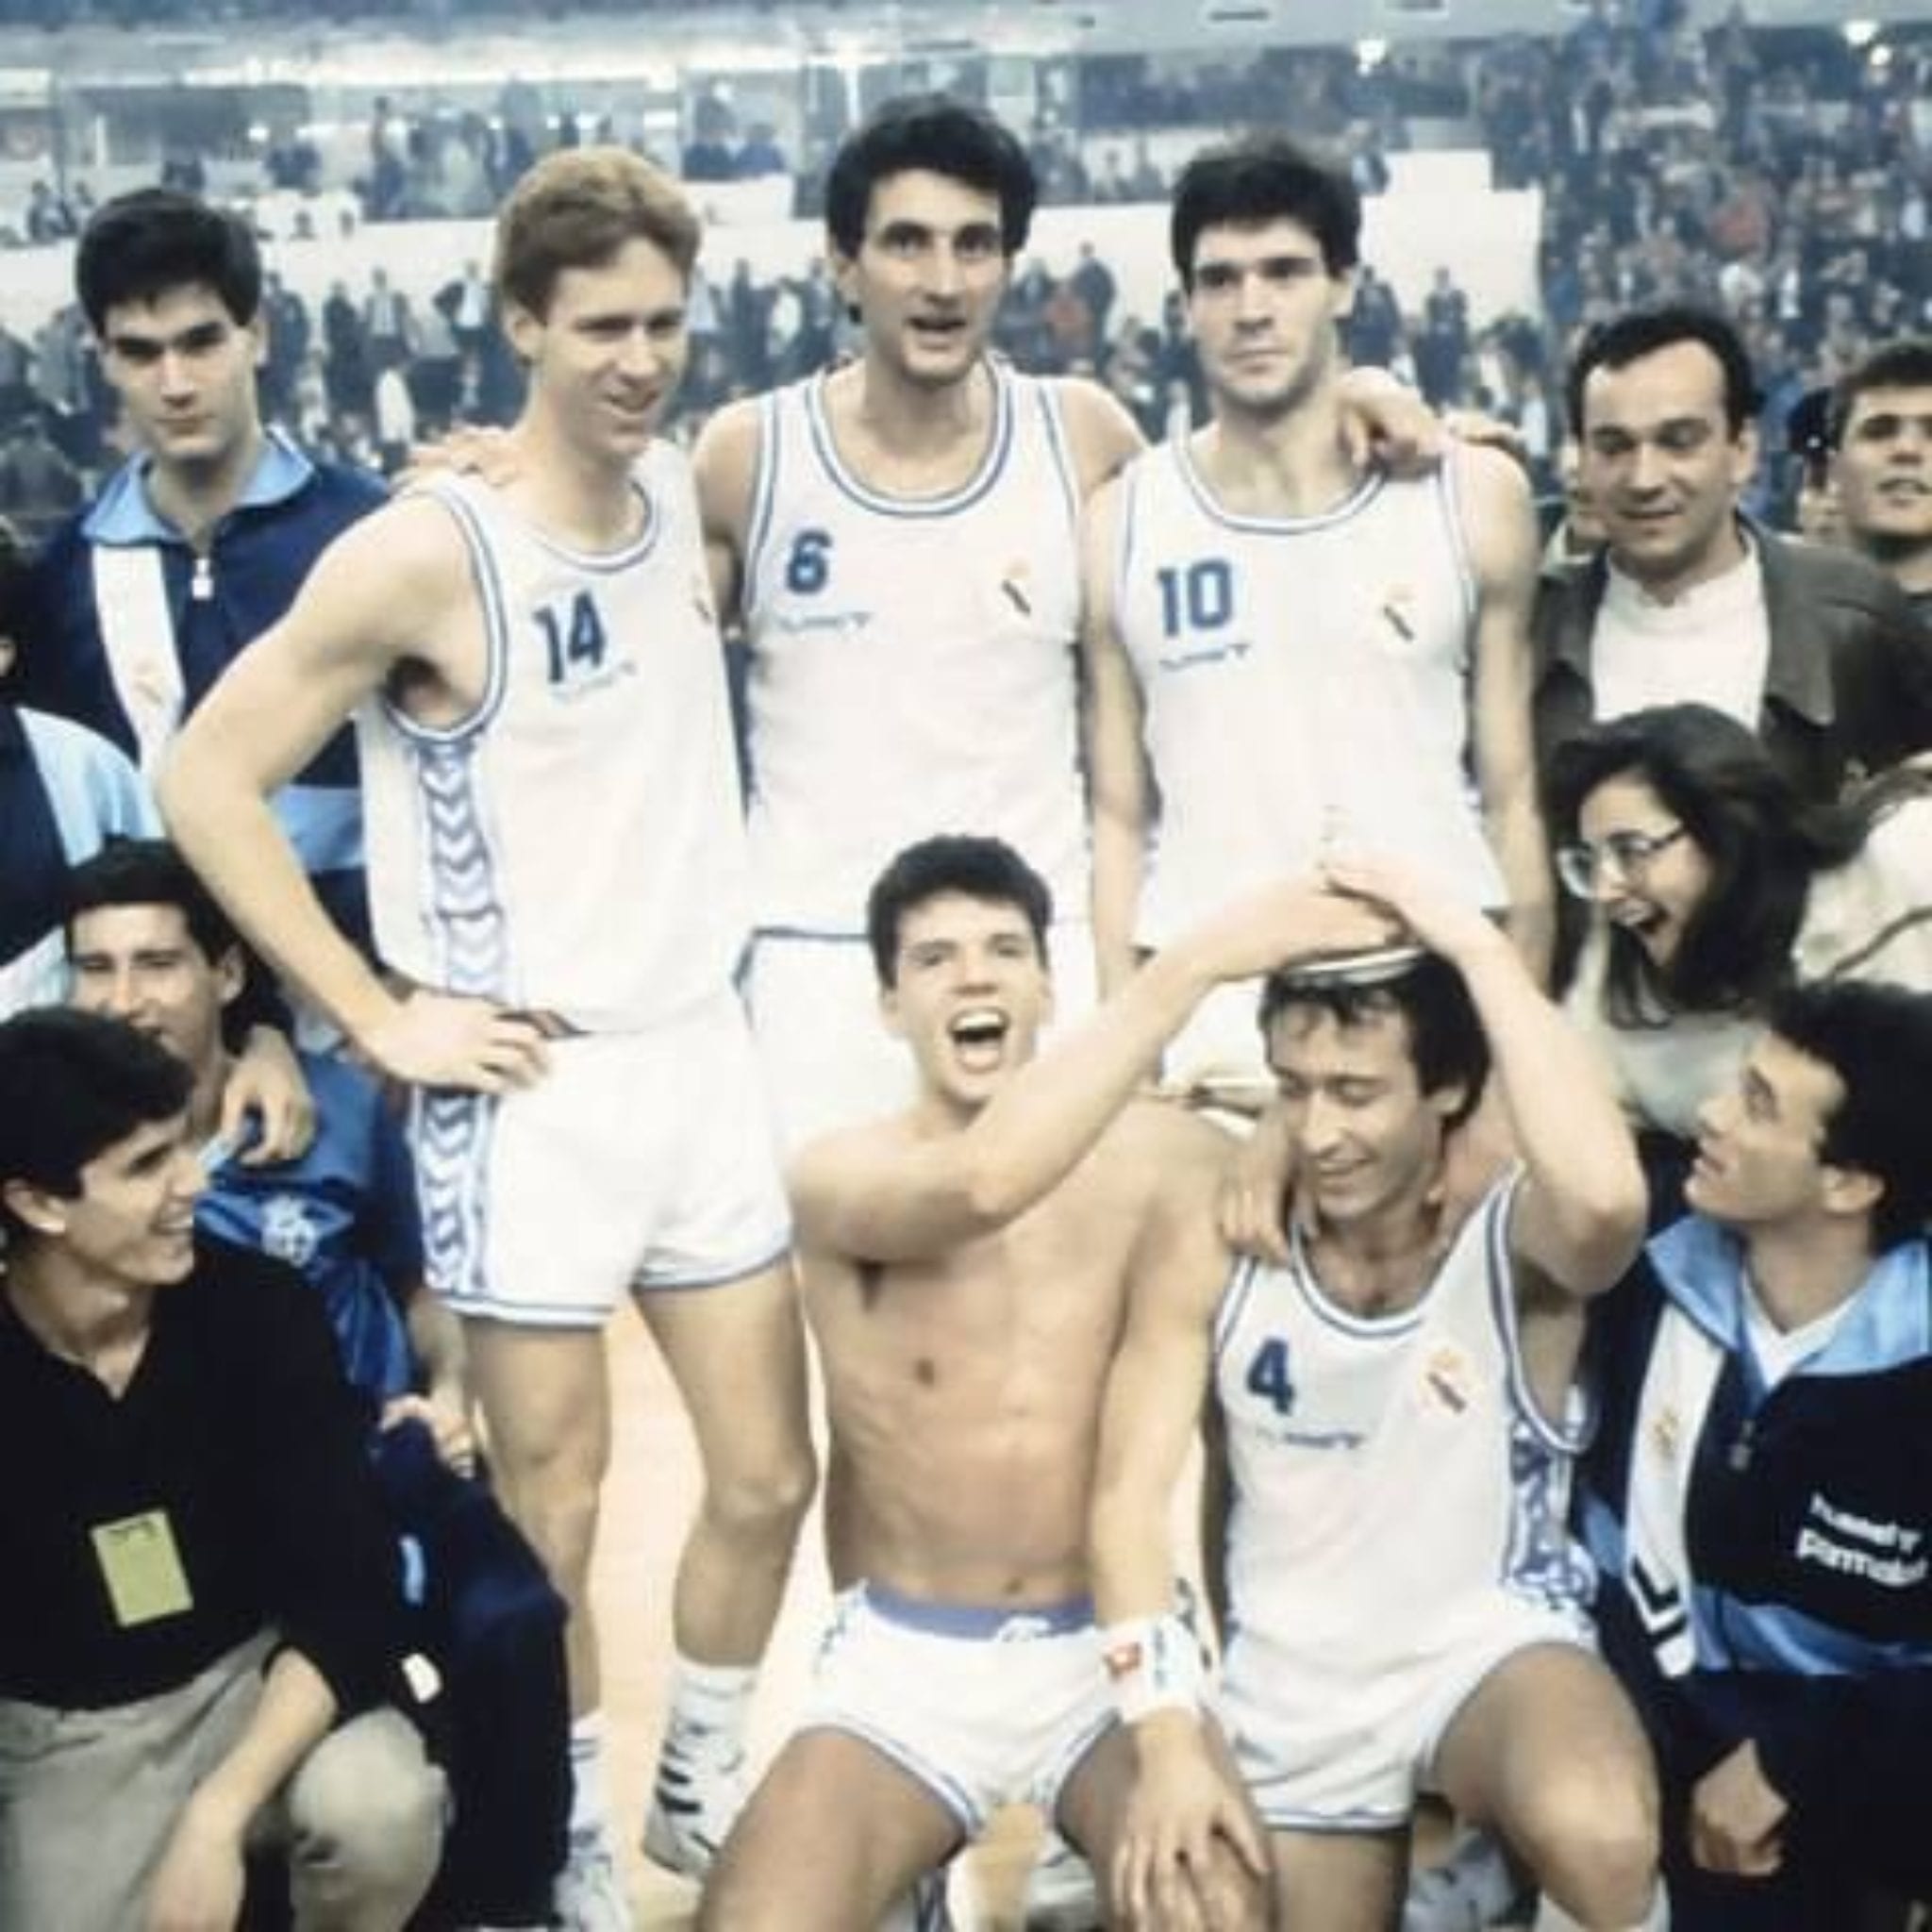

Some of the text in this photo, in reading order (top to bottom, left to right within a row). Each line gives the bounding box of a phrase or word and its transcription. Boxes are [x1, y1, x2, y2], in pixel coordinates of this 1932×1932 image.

[786, 530, 831, 593] 6
[1158, 558, 1232, 637] 10
[532, 589, 605, 683] 14
[1246, 1338, 1296, 1414] 4
